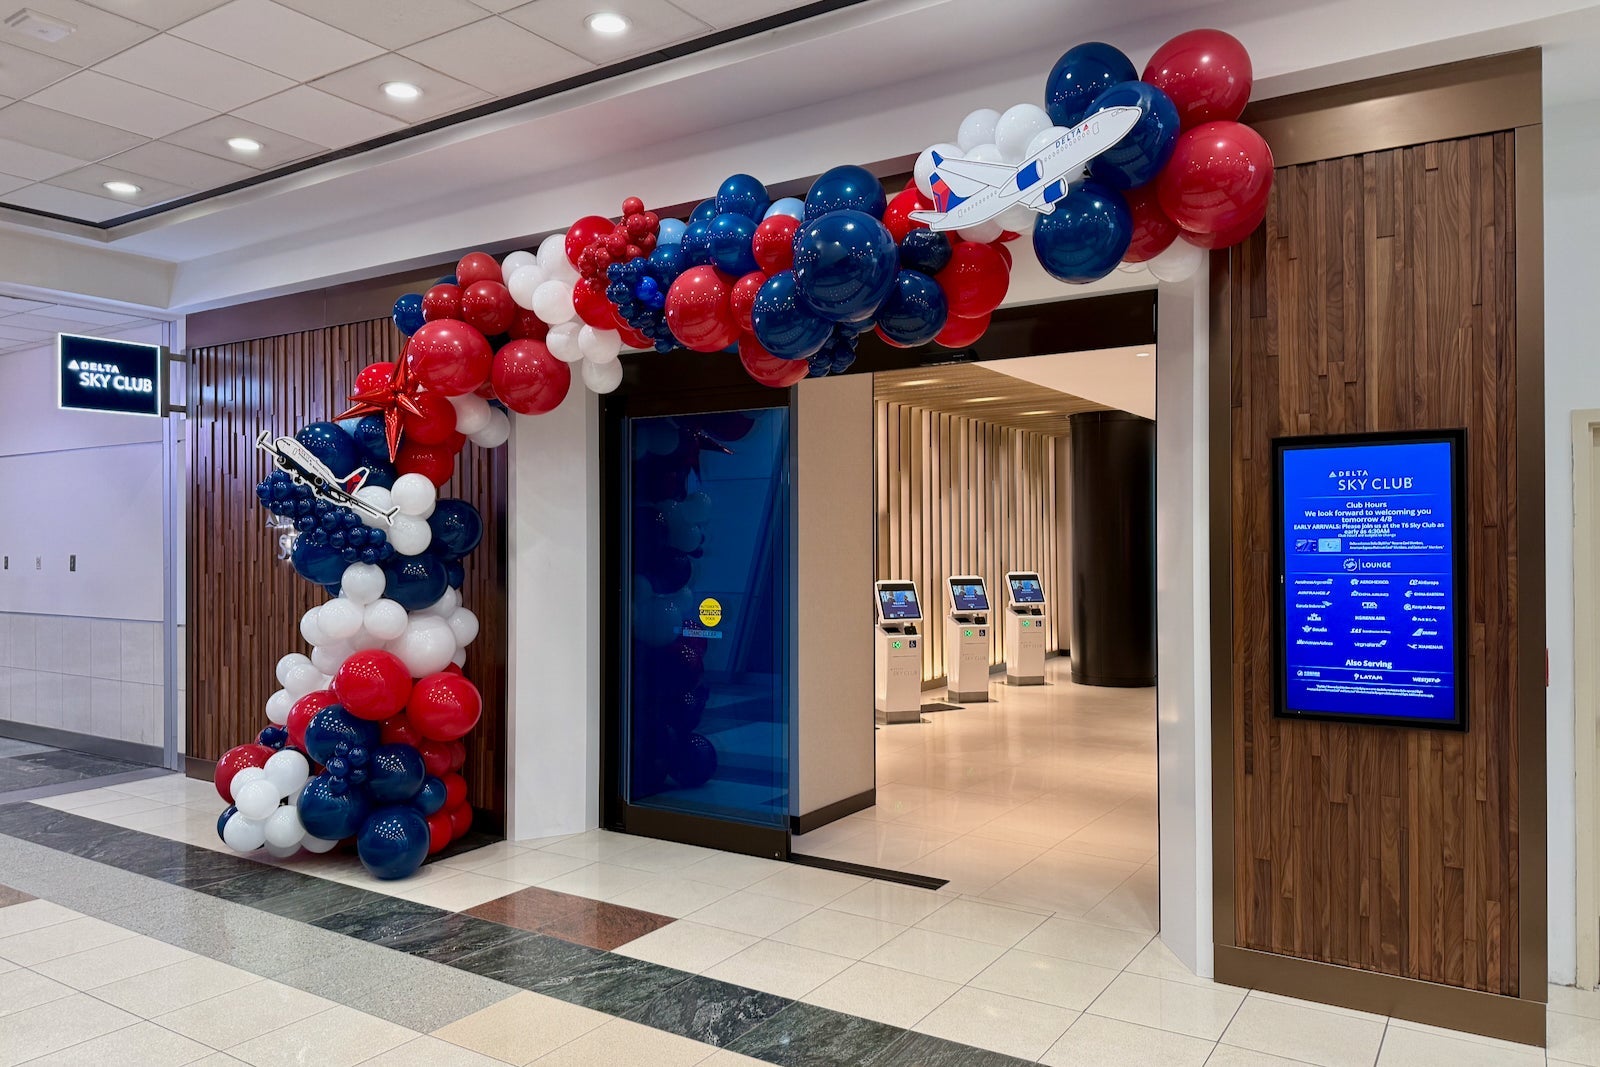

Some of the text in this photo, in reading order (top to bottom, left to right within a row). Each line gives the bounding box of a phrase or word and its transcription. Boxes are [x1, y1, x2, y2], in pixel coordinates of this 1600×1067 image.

[1055, 128, 1081, 149] DELTA
[80, 361, 119, 374] DELTA
[79, 372, 153, 392] SKY CLUB
[1338, 477, 1413, 491] SKY CLUB
[1317, 509, 1334, 517] look
[1334, 509, 1364, 517] forward
[1374, 508, 1416, 517] welcoming
[1417, 509, 1432, 517] you
[1380, 515, 1393, 523] 4/8
[1409, 521, 1421, 530] Sky
[1345, 659, 1393, 669] Also Serving
